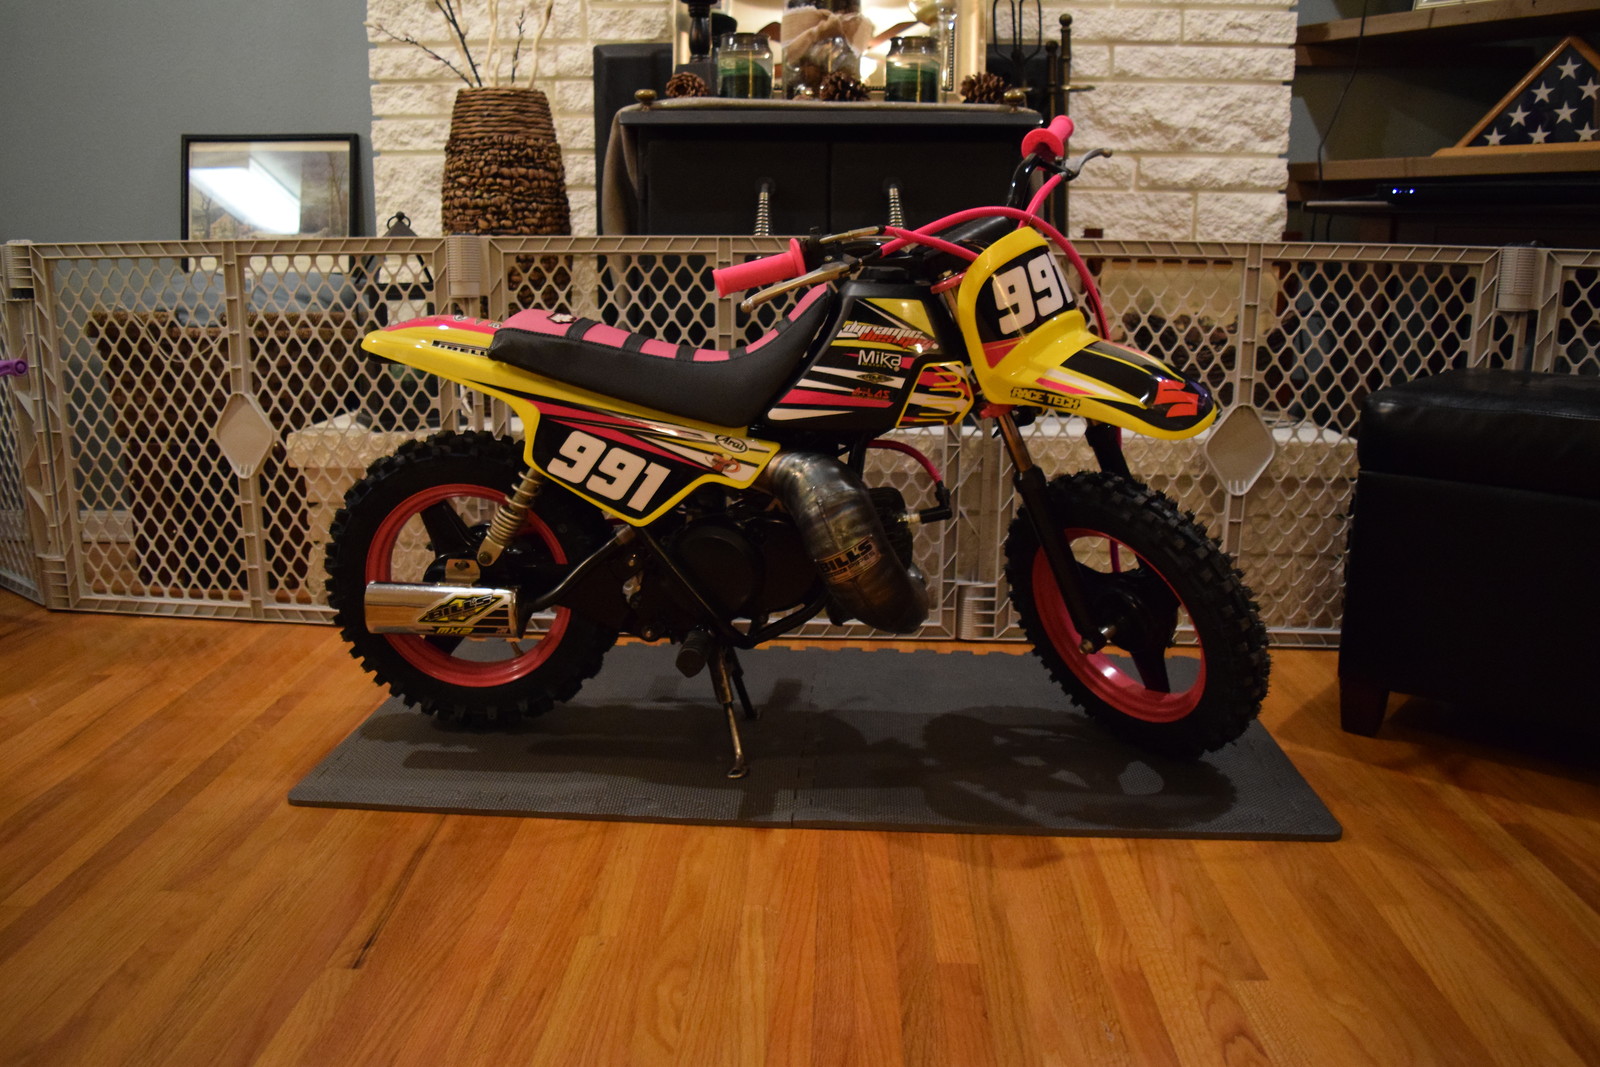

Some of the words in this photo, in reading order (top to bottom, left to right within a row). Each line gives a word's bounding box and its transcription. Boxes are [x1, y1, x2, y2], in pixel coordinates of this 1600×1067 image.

[992, 252, 1074, 335] 991
[858, 349, 902, 370] Mika
[1011, 388, 1045, 402] RACE
[1047, 393, 1080, 409] TECH
[722, 436, 745, 450] Arai
[547, 430, 671, 512] 991
[437, 626, 474, 635] MX2
